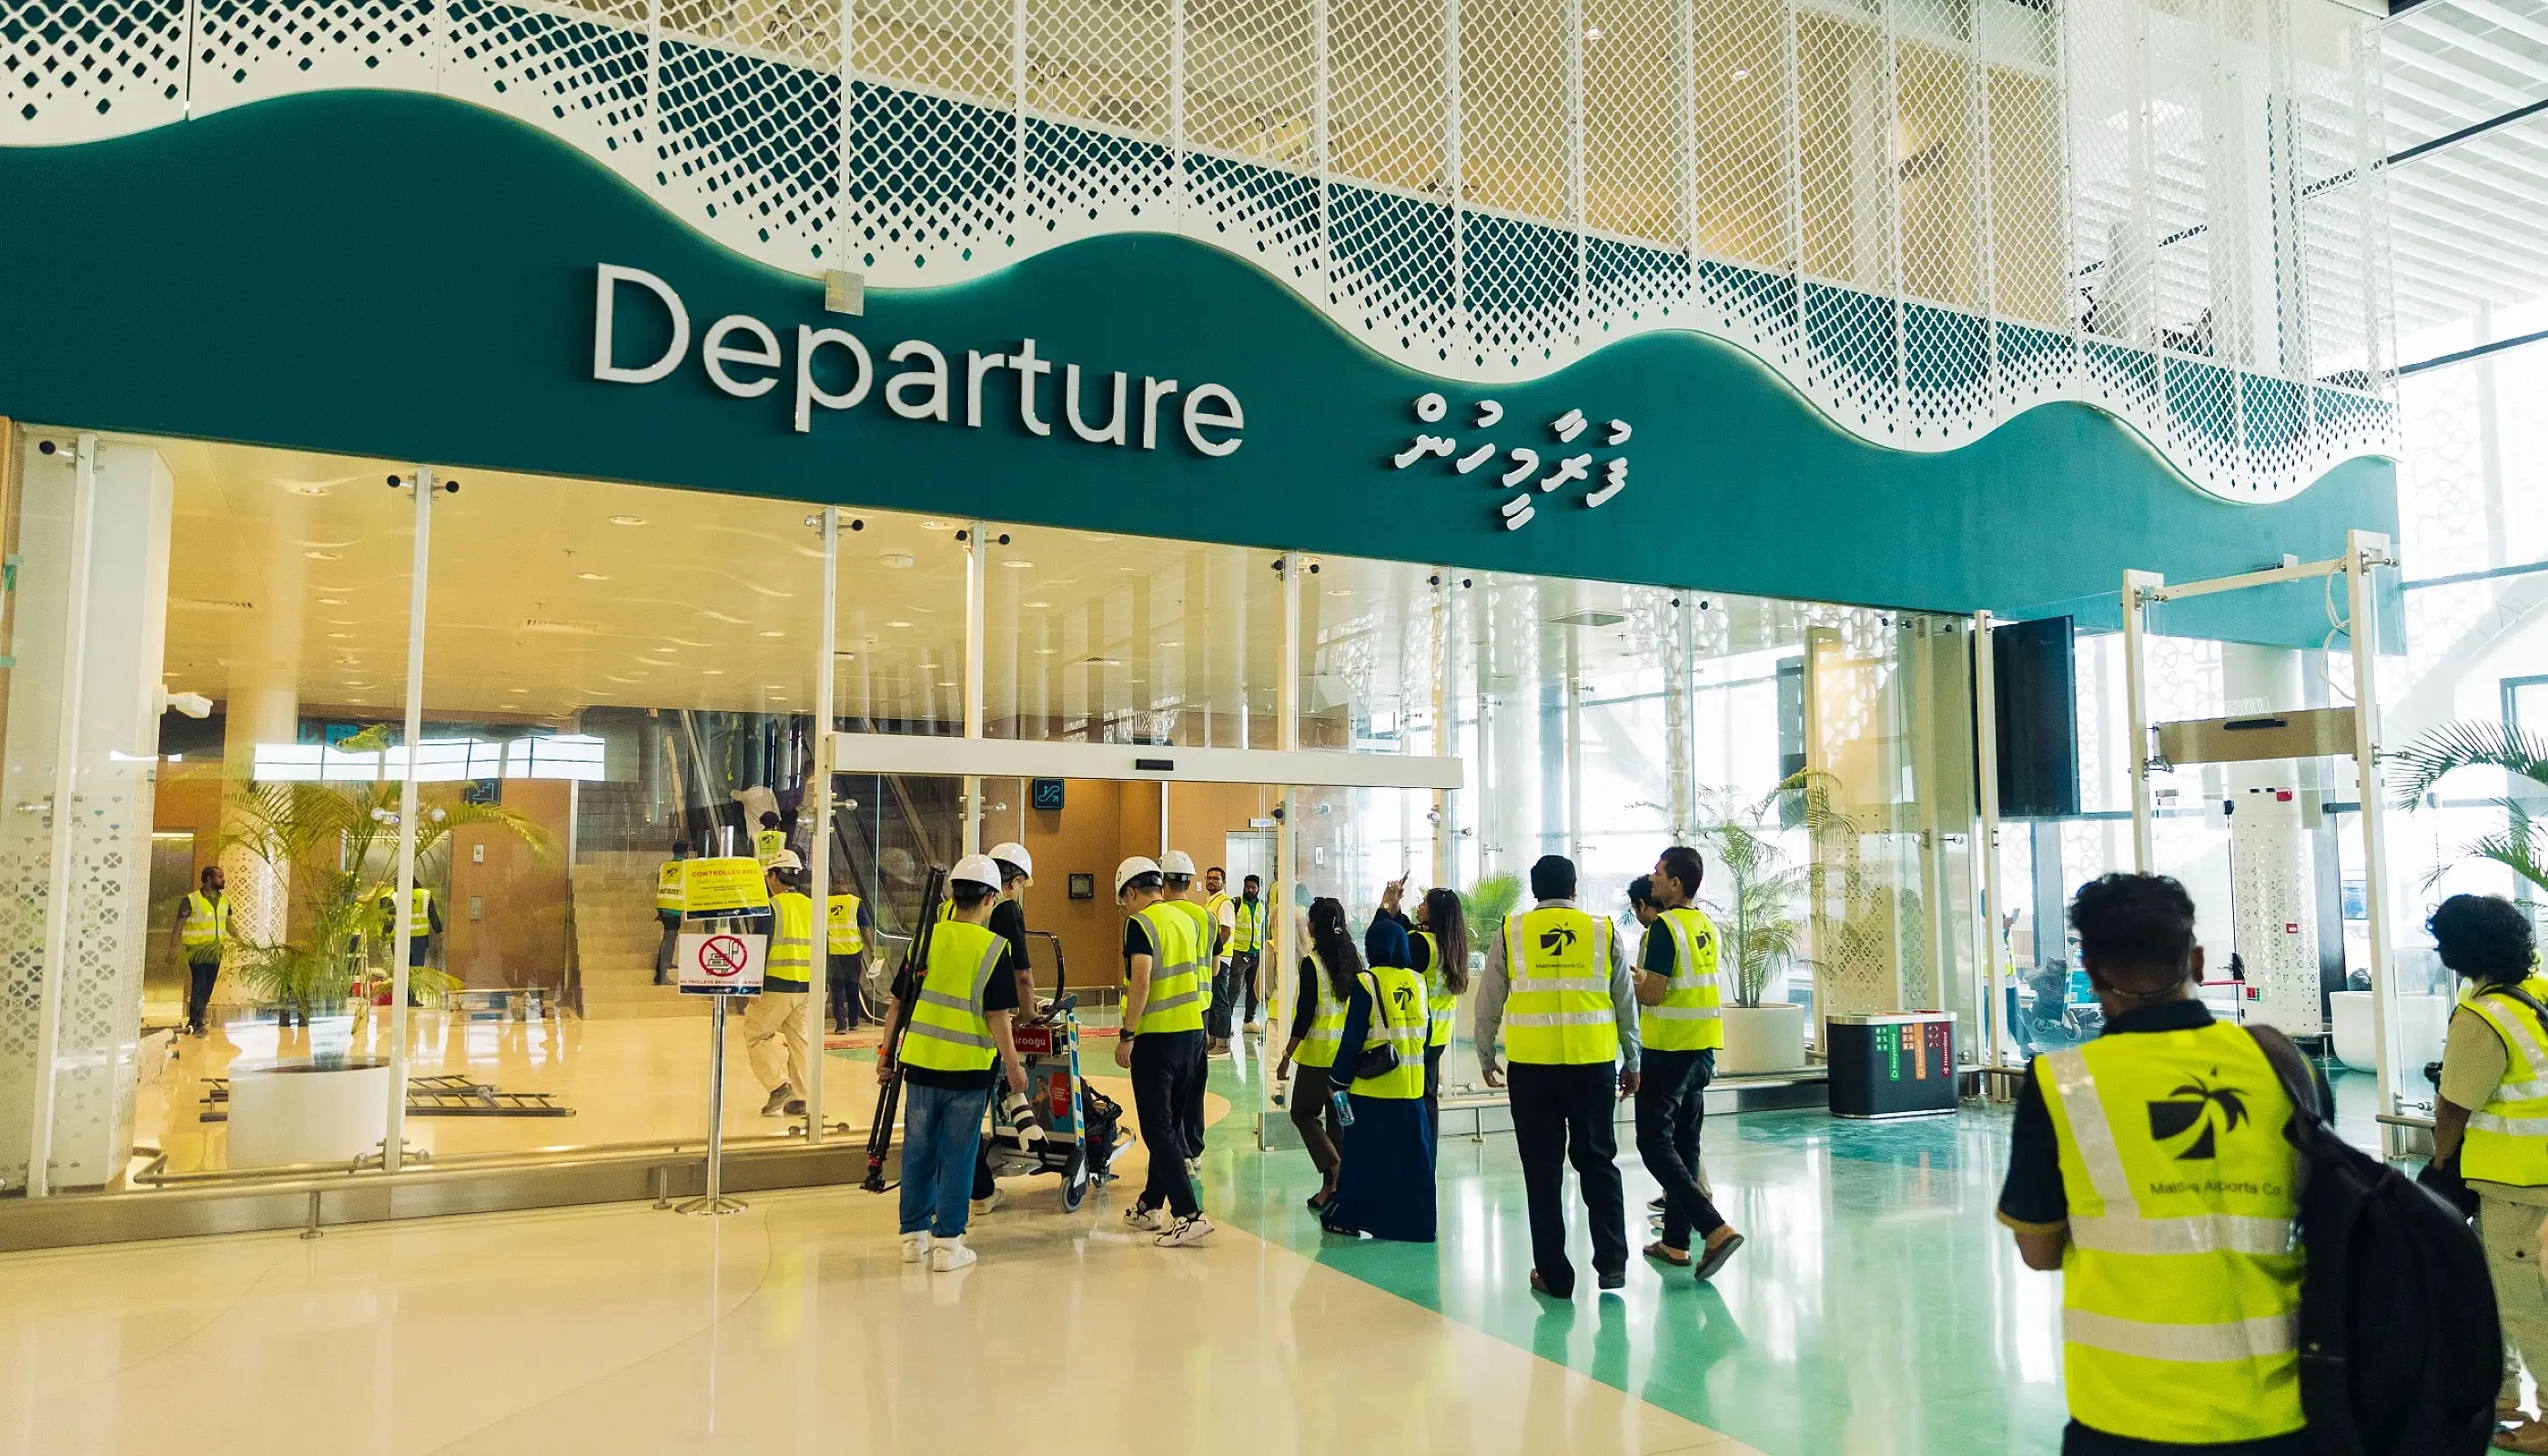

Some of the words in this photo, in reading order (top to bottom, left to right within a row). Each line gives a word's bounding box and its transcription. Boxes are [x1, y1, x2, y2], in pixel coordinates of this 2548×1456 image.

[593, 262, 1245, 457] Departure
[692, 869, 741, 877] CONTROLLED
[1015, 1036, 1046, 1047] iraagu
[2149, 1181, 2200, 1195] Maldes
[2204, 1179, 2259, 1195] Aiports
